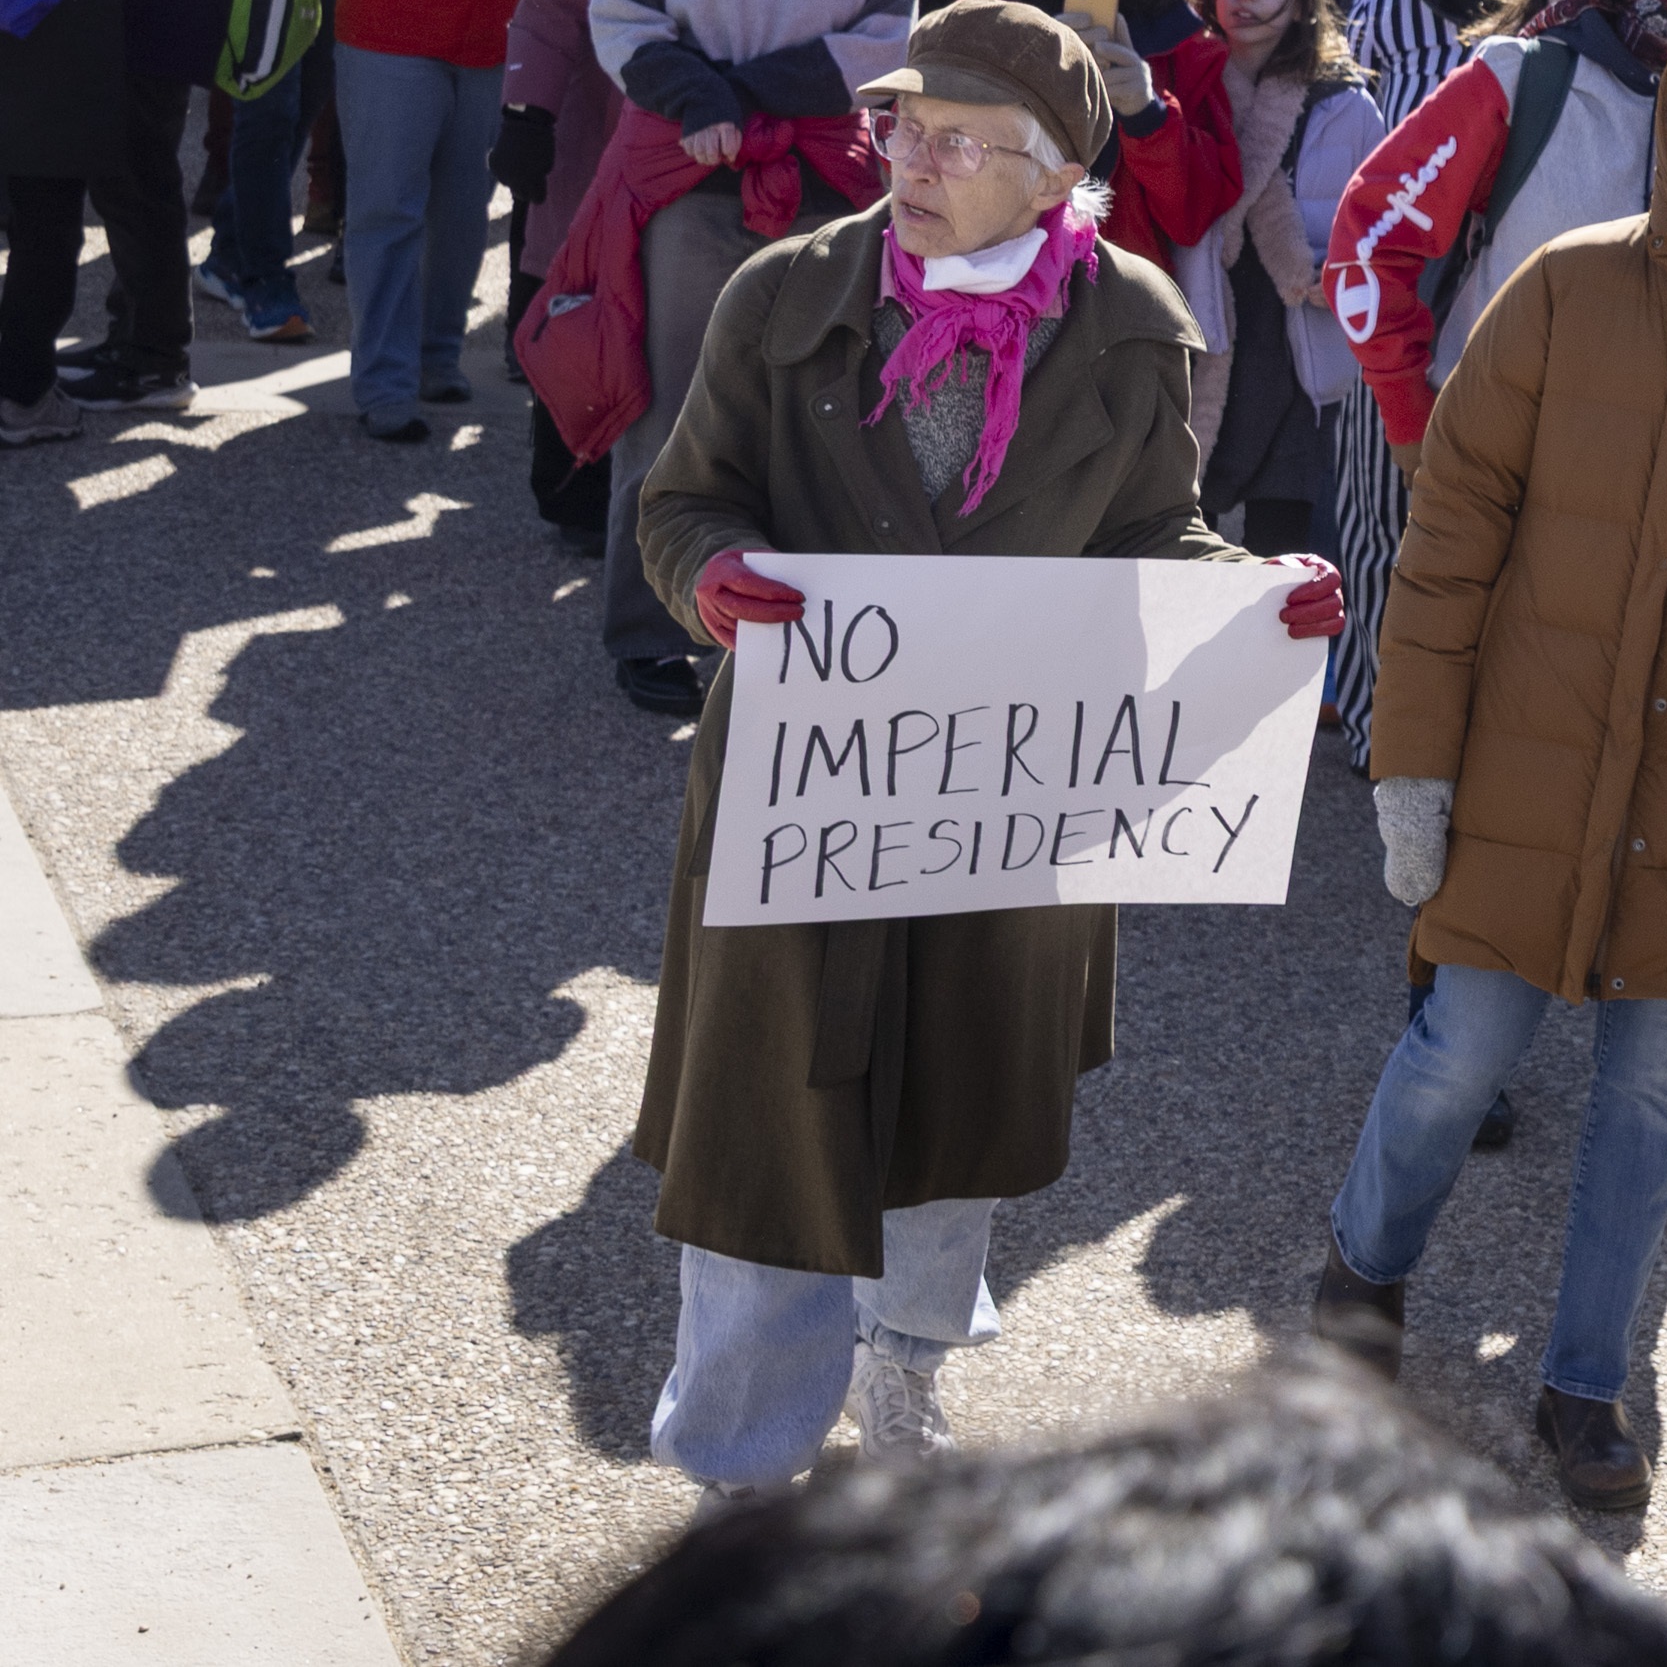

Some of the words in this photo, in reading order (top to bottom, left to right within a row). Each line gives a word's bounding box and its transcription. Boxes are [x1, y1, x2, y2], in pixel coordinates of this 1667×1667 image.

[779, 599, 899, 683] NO
[768, 694, 1211, 807] IMPERIAL
[761, 794, 1260, 905] PRESIDENCY
